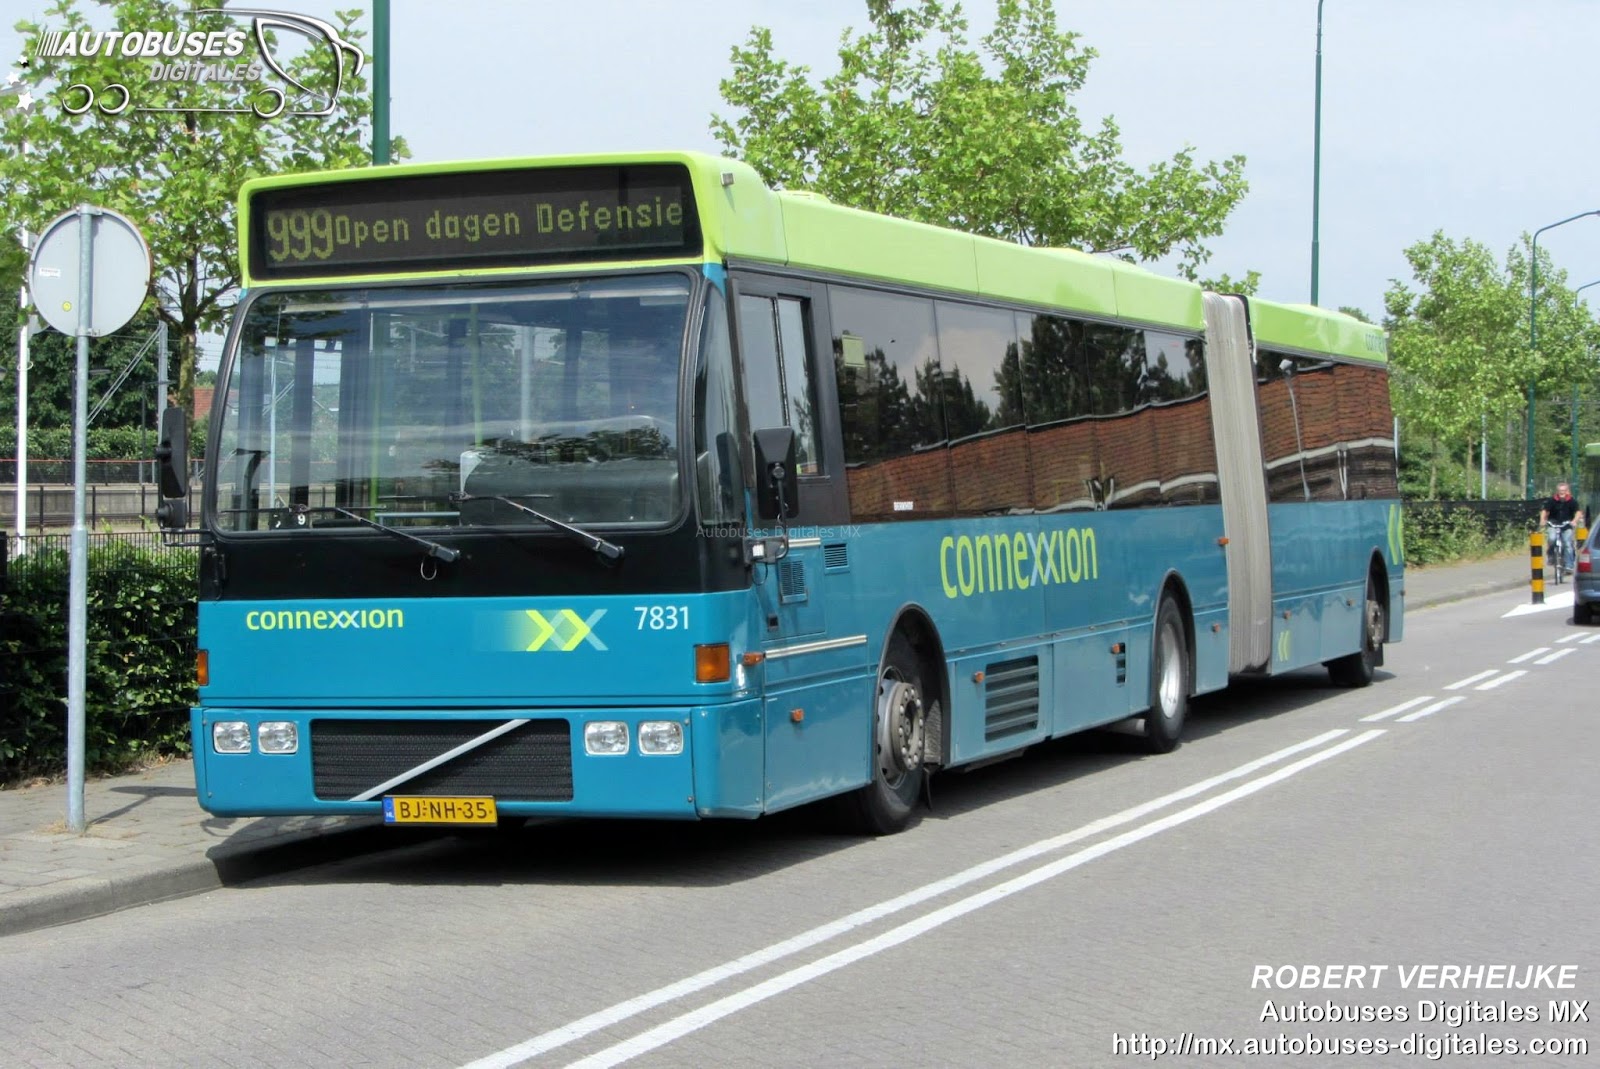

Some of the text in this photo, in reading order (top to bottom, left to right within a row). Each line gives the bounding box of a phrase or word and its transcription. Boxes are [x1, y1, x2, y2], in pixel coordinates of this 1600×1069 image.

[267, 197, 683, 262] 999 Open dagen Defensie
[939, 527, 1098, 599] connexxion
[246, 608, 404, 631] connexxion
[633, 605, 690, 631] 7831
[399, 800, 488, 820] BJ-NH-35
